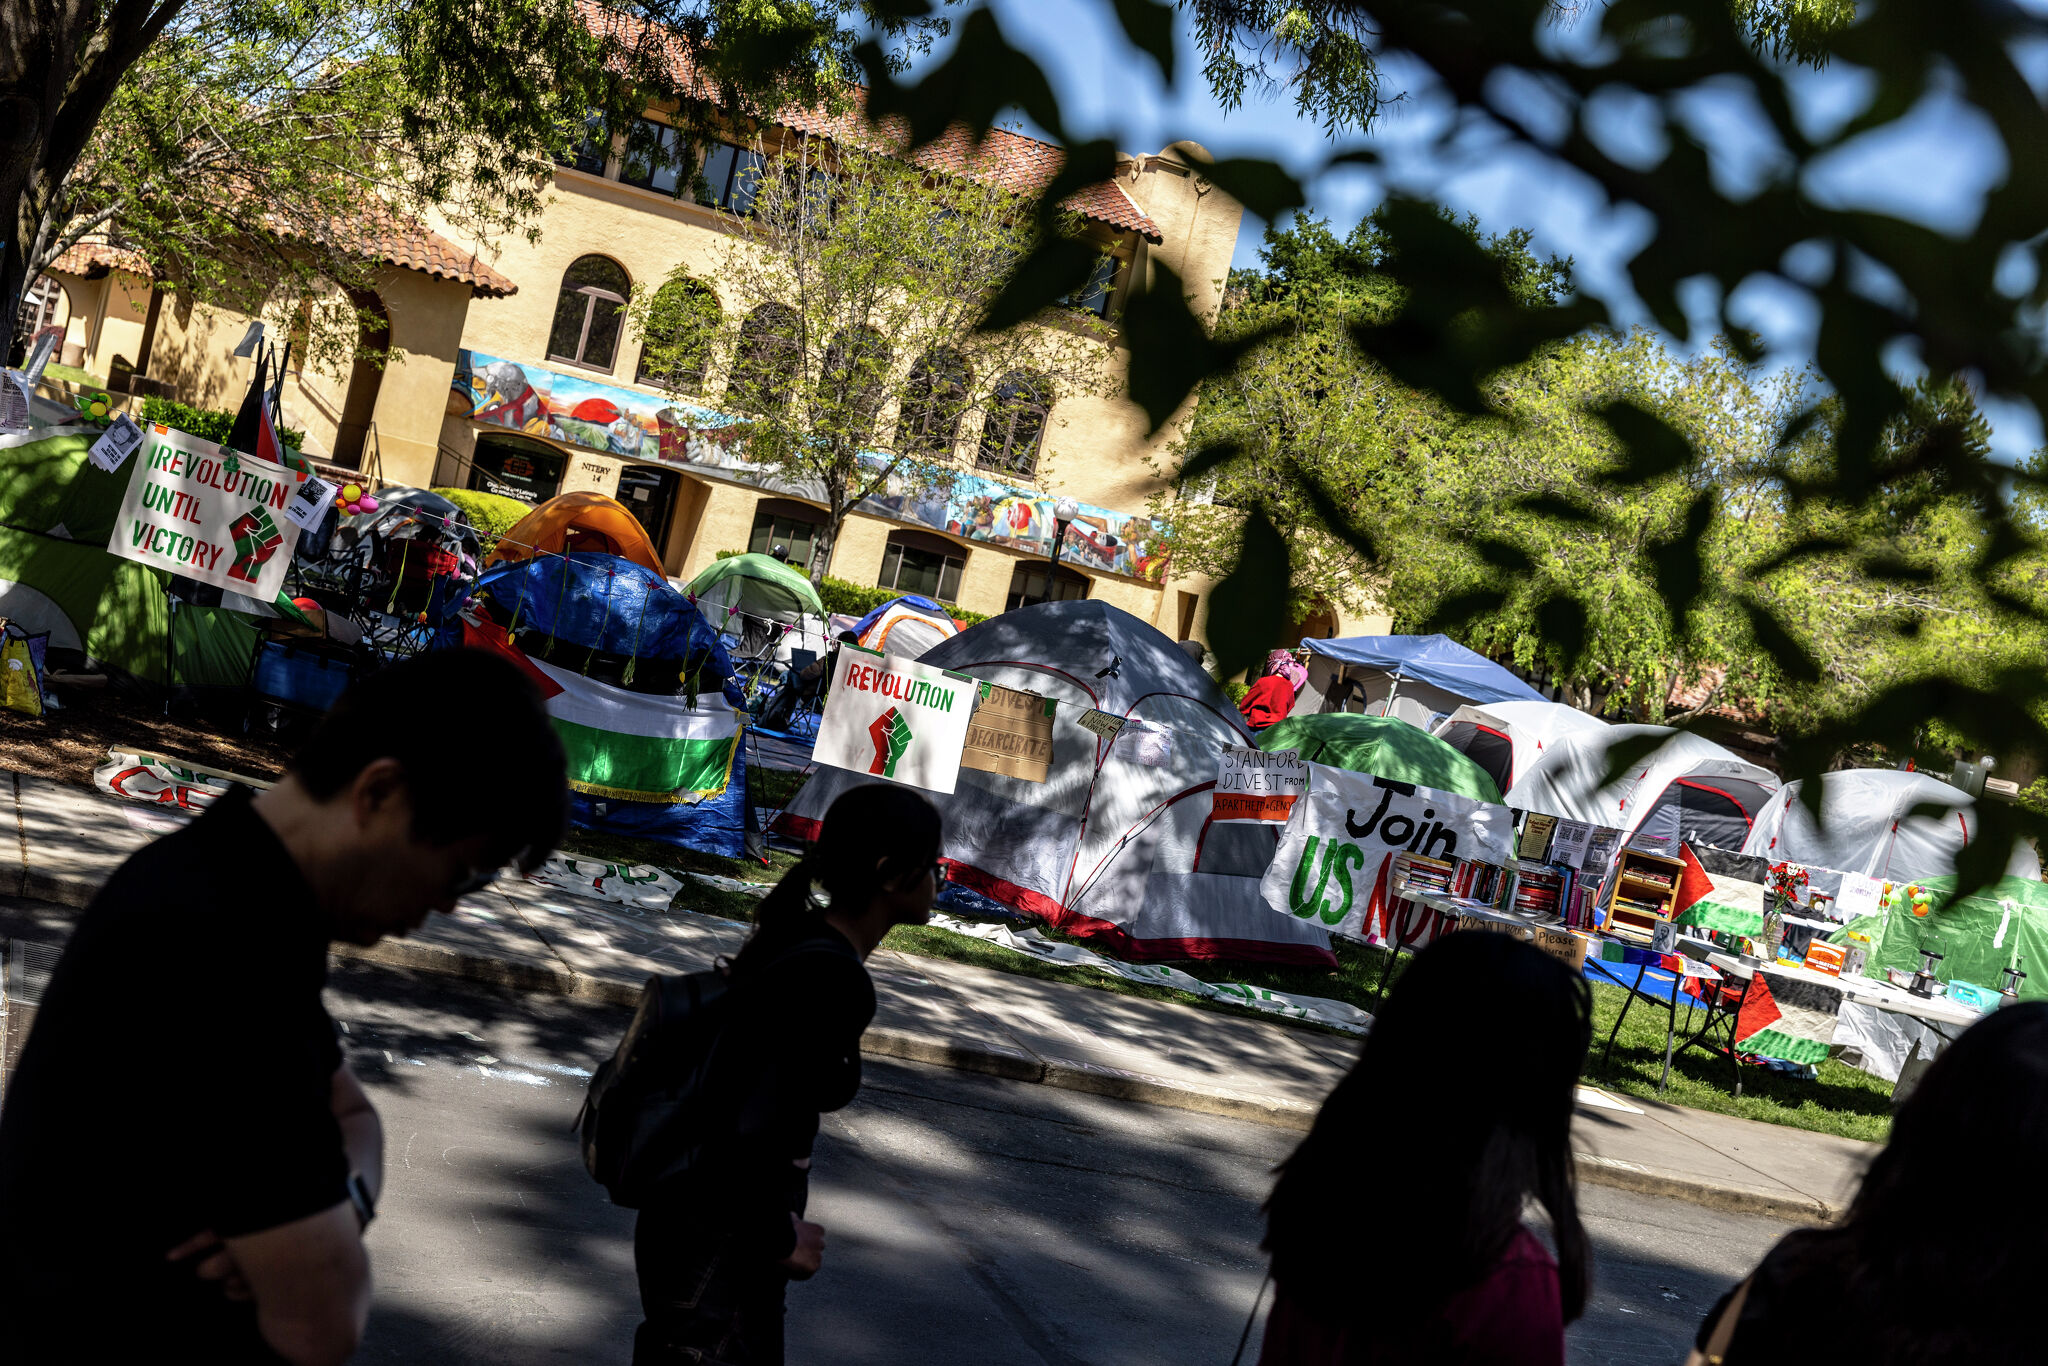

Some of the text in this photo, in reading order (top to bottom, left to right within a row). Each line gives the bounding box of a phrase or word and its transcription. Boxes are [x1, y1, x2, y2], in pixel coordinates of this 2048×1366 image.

[153, 444, 289, 510] REVOLUTION
[582, 462, 611, 475] NITERY
[592, 474, 601, 483] 14
[142, 481, 202, 525] UNTIL
[131, 519, 224, 571] VICTORY
[846, 663, 955, 712] REVOLUTION
[991, 688, 1046, 714] DIVEST
[970, 728, 1048, 756] DECARCERATE
[1223, 772, 1305, 791] DIVEST FROM
[1345, 776, 1457, 857] Join
[1289, 835, 1364, 925] US
[1538, 931, 1575, 946] Please
